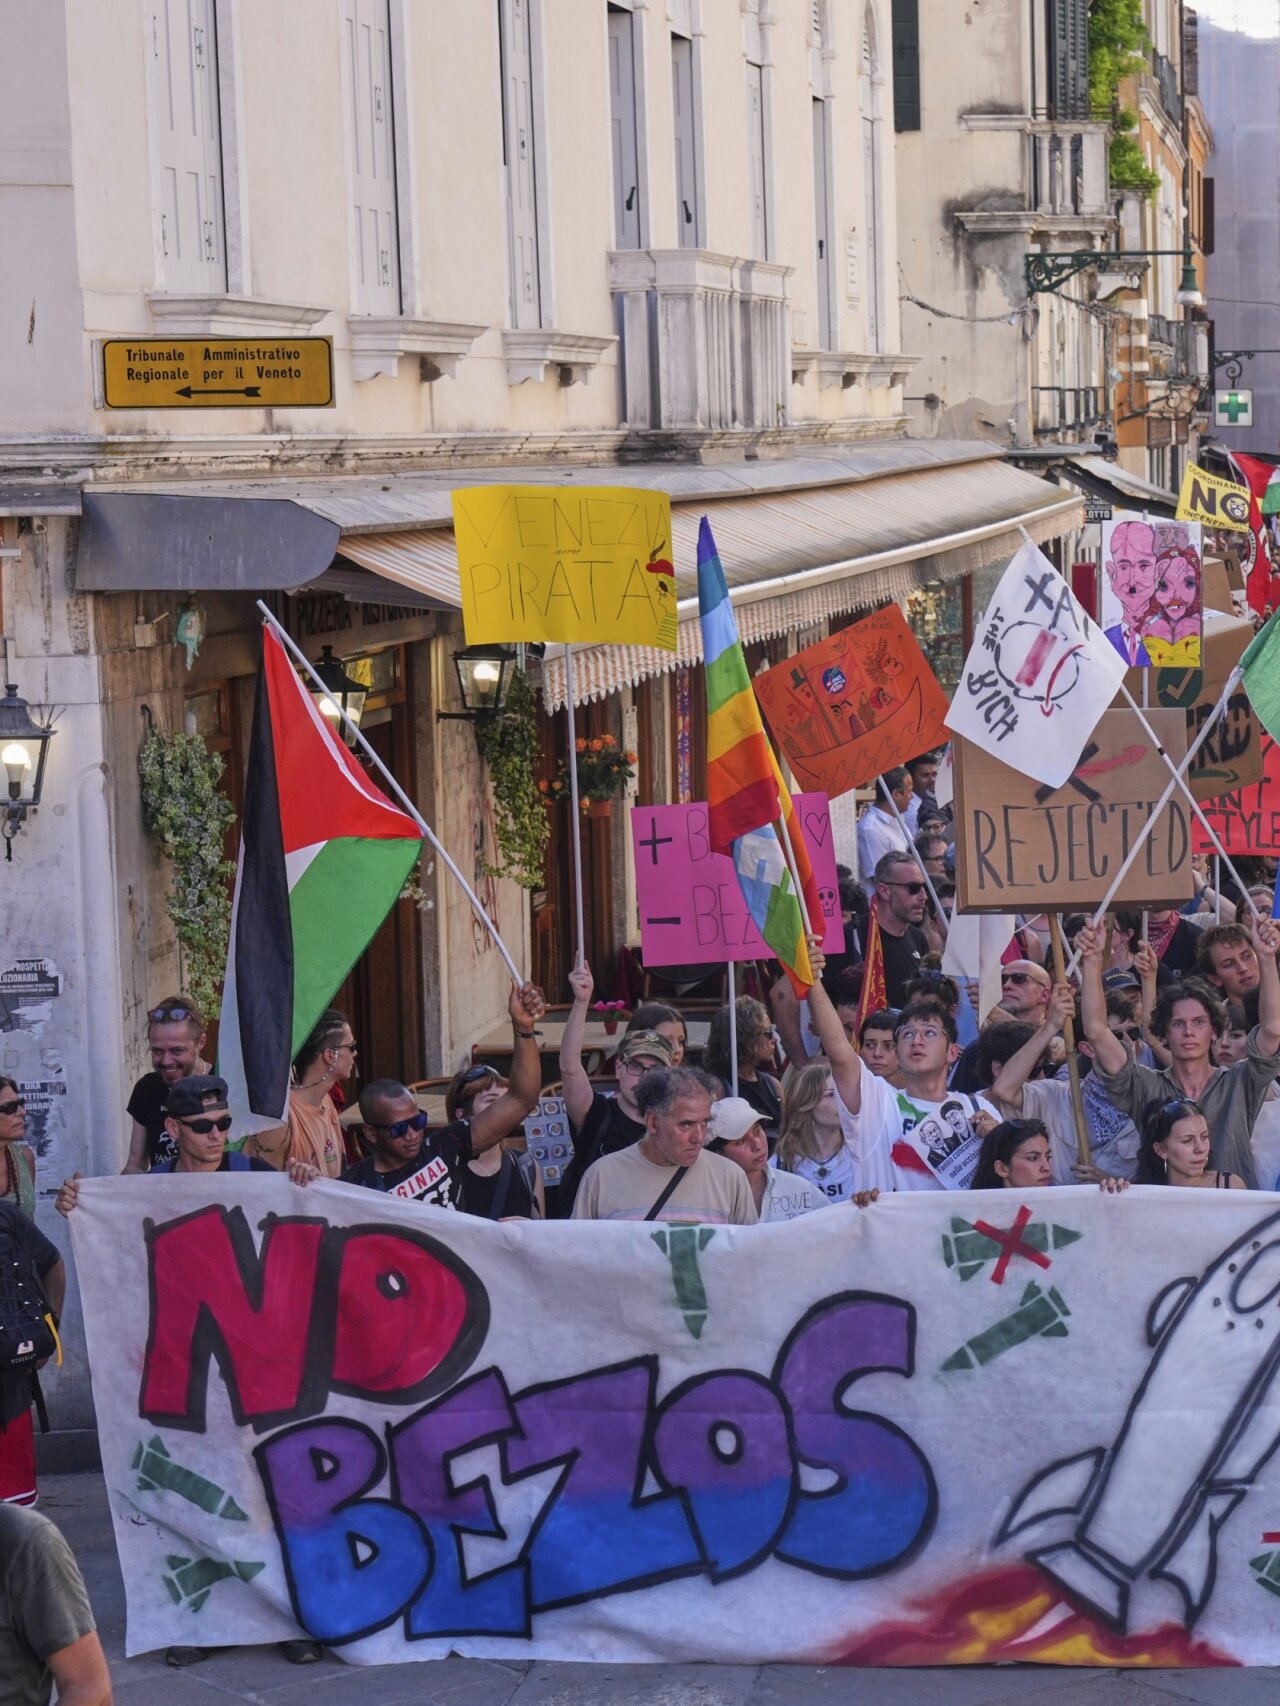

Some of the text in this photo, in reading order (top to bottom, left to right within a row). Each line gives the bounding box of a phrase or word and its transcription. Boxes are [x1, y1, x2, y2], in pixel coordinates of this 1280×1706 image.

[126, 347, 300, 362] Tribunale Amministrativo
[127, 366, 301, 383] Regionale per il Veneto
[457, 495, 670, 549] VENEZIA
[1189, 477, 1250, 524] NO
[469, 558, 659, 625] PIRATA
[973, 799, 1188, 890] REJECTED
[139, 1202, 492, 1434] NO
[252, 1290, 939, 1646] BEZOS
